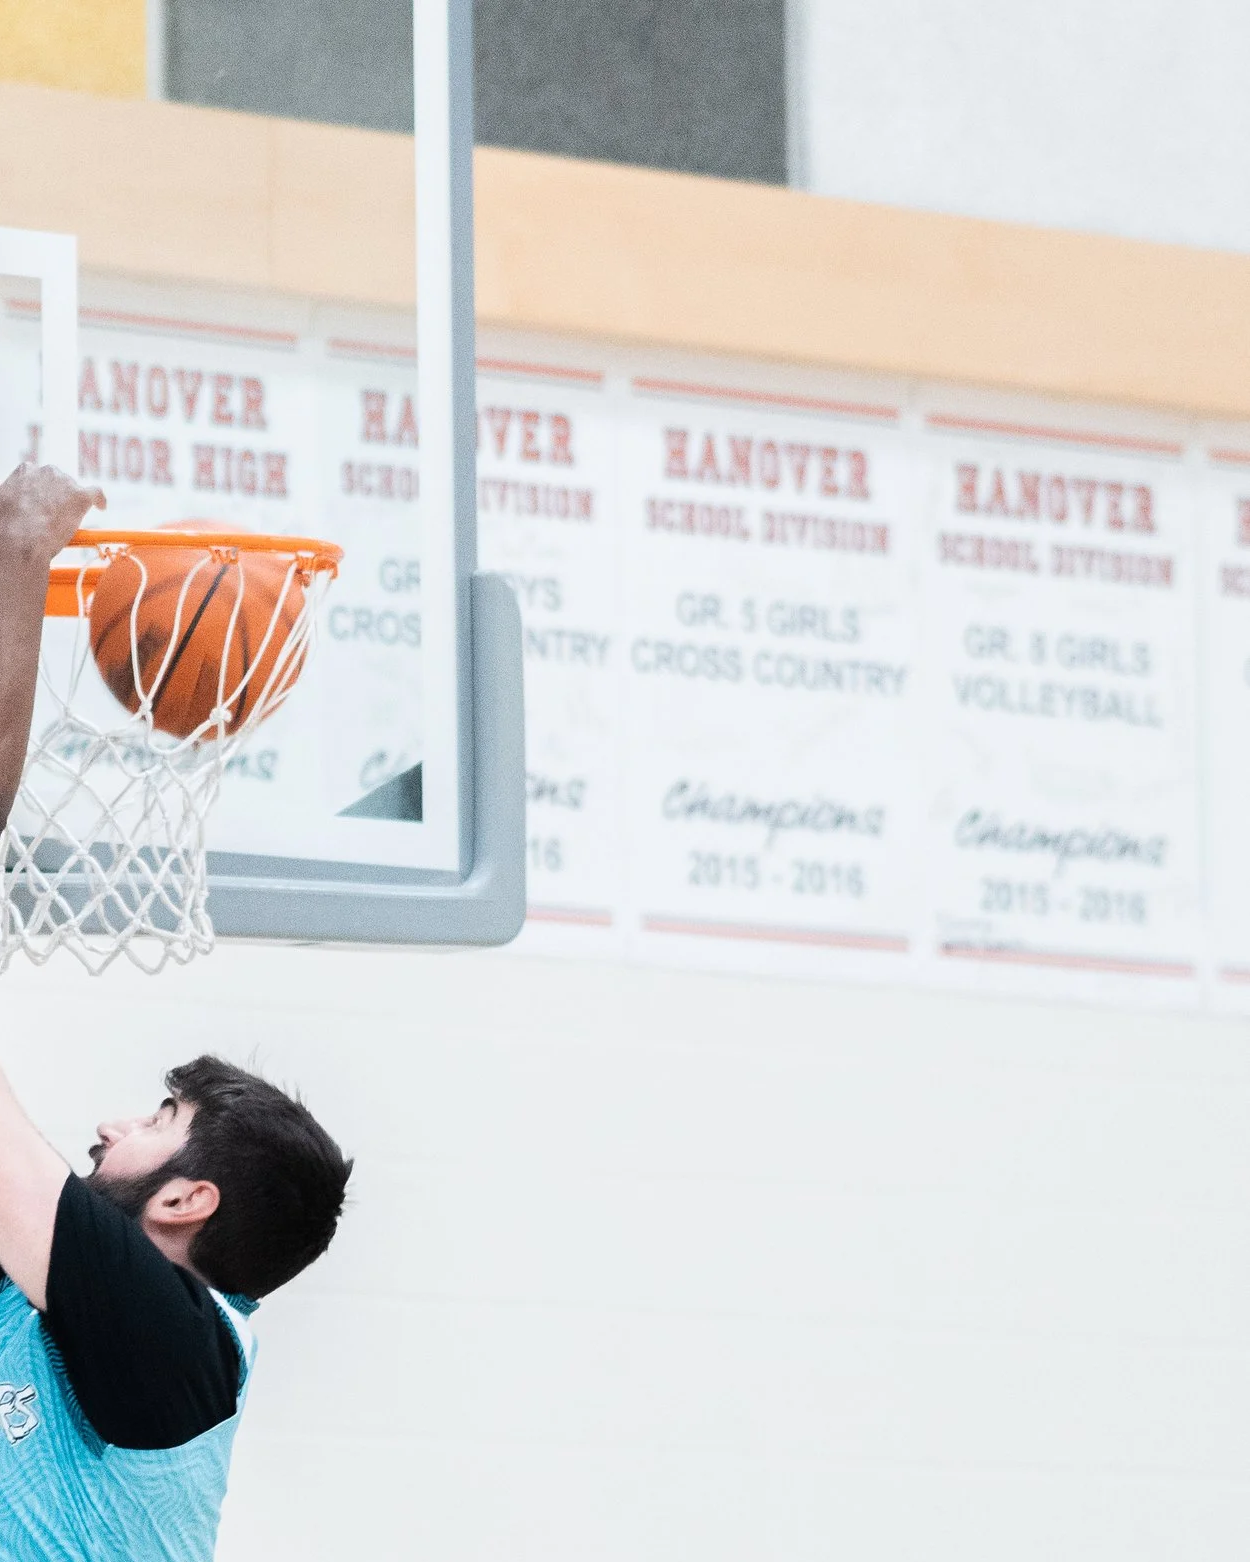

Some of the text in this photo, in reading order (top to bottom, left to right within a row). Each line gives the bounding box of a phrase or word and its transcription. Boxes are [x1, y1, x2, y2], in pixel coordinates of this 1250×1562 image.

[37, 352, 268, 432] ANOVER
[192, 443, 288, 498] HIGH
[663, 427, 871, 500] HANOVER
[645, 496, 890, 557] SCHOOL DIVISION
[954, 462, 1157, 534] HANOVER
[937, 532, 1041, 576] SCHOOL
[1051, 545, 1175, 589] DIVISION
[767, 601, 861, 645] GIRLS
[631, 638, 908, 696] CROSS COUNTRY
[952, 675, 1163, 728] VOLLEYBALL
[662, 778, 885, 851] Champions
[954, 808, 1169, 876] Champions
[687, 850, 761, 891] 2015
[791, 859, 867, 900] 2016
